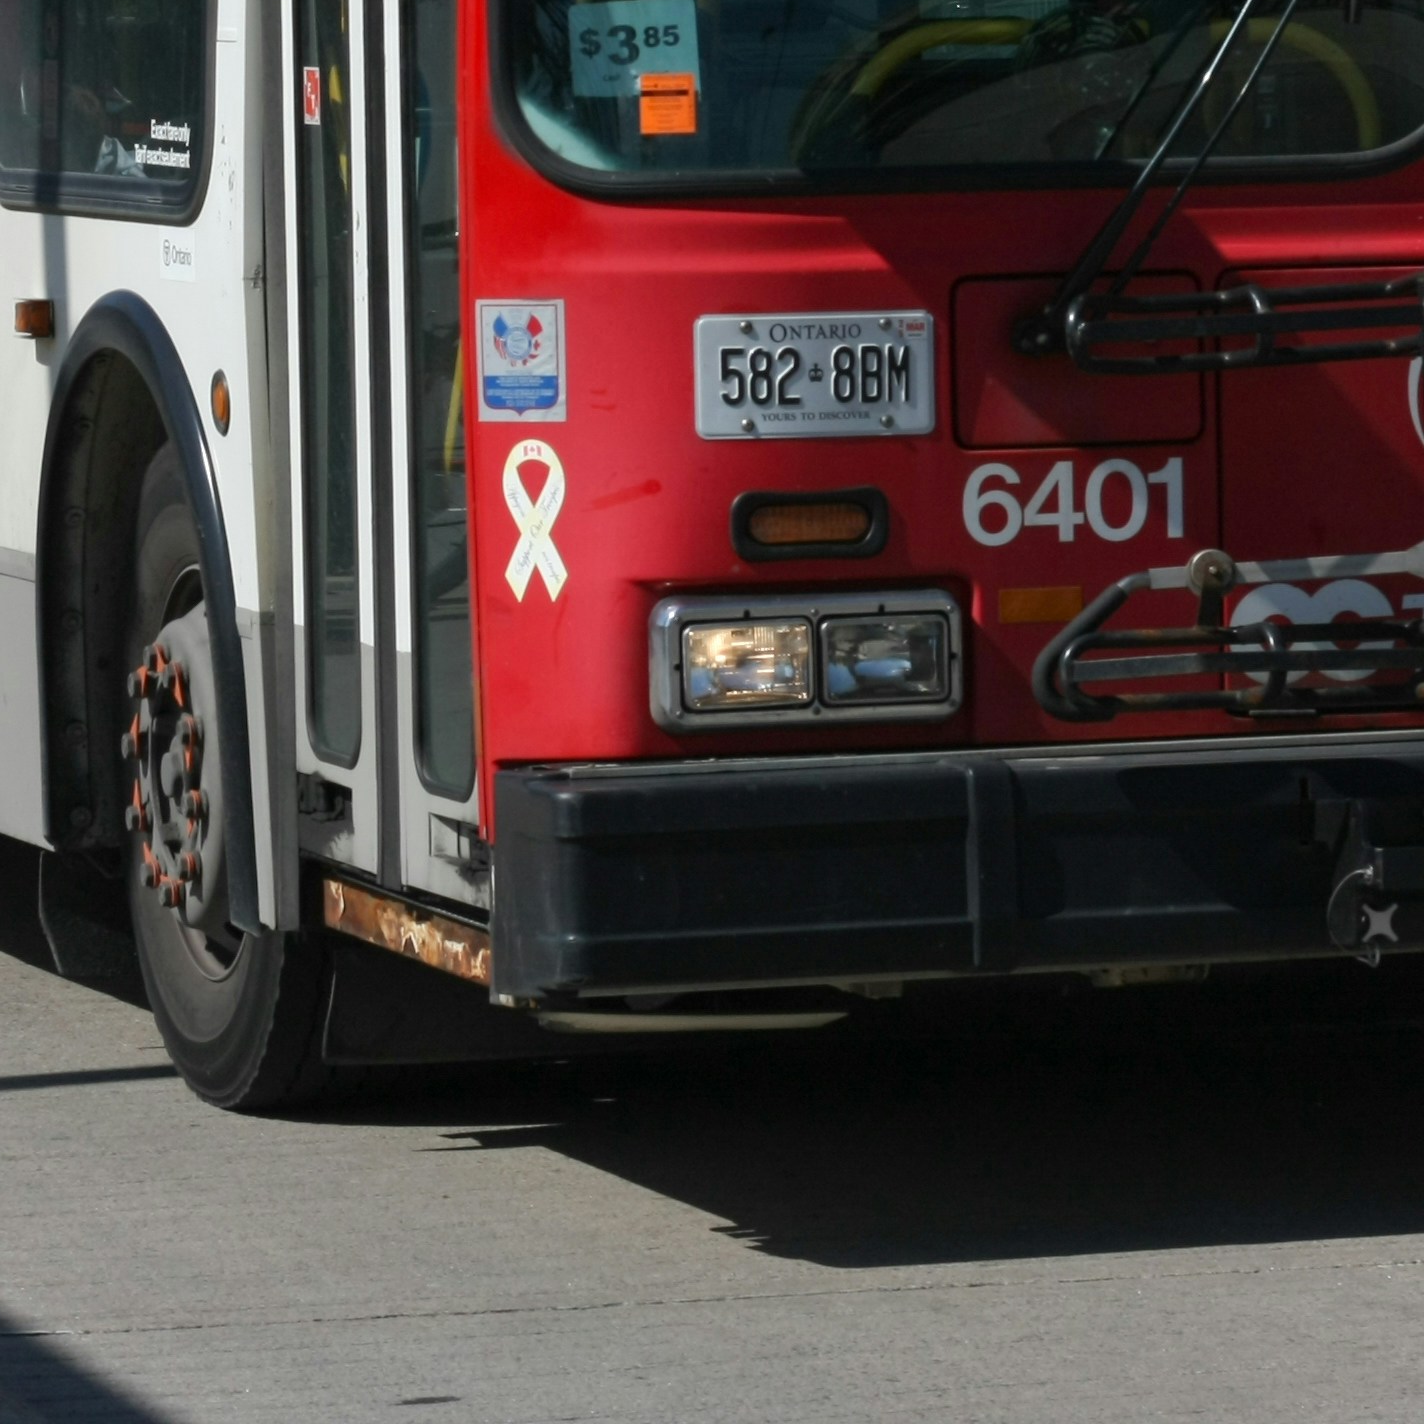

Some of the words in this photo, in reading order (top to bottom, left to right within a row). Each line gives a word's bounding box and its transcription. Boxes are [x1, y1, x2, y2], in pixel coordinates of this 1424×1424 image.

[770, 324, 861, 343] ONTARIO
[720, 345, 802, 406] 582
[832, 343, 910, 404] 8BM
[761, 412, 796, 422] YOURS
[802, 412, 815, 421] TO
[819, 410, 870, 421] DISCOVER
[962, 457, 1184, 546] 6401
